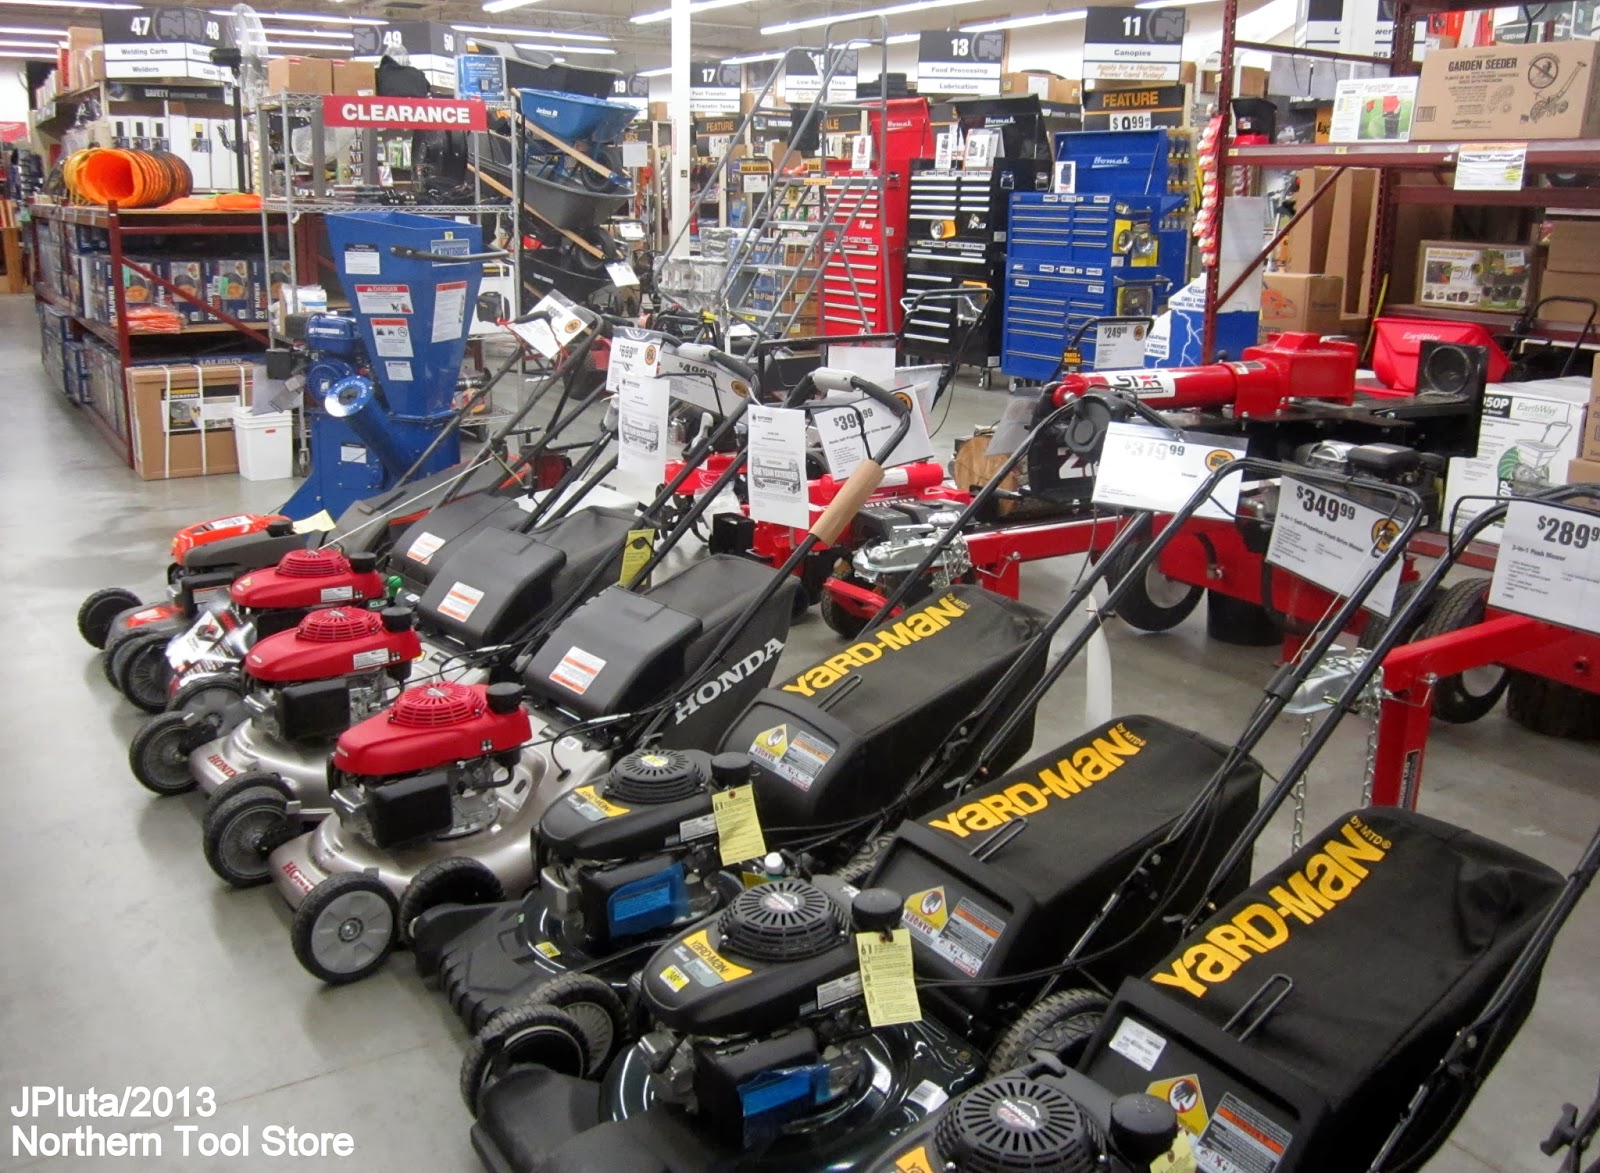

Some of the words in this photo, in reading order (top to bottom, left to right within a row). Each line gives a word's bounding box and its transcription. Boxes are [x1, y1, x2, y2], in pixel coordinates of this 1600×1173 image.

[131, 17, 150, 36] 47
[206, 21, 219, 40] 48
[1123, 16, 1140, 36] 11
[383, 32, 401, 47] 49
[444, 34, 453, 52] 50
[121, 47, 148, 56] Welding
[150, 47, 168, 55] Carts
[951, 39, 968, 56] 13
[1114, 49, 1151, 58] Canopies
[950, 67, 988, 75] Processing
[1448, 60, 1482, 72] GARDEN
[1485, 58, 1518, 70] SEEDER
[702, 69, 715, 82] 17
[614, 80, 626, 92] 19
[1103, 91, 1158, 107] FEATURE
[342, 104, 470, 124] CLEARANCE
[985, 116, 1015, 124] Homak
[706, 121, 734, 131] FEATURE
[1094, 156, 1130, 165] Homak
[1403, 332, 1442, 341] EarthWay
[1516, 402, 1557, 417] EarthWay
[1296, 485, 1356, 522] $34999
[1537, 515, 1600, 549] $2899
[1530, 548, 1544, 557] Push
[1546, 551, 1566, 561] Mower
[675, 637, 784, 725] HONDA
[208, 754, 237, 777] HOND
[1350, 815, 1361, 828] by
[904, 911, 933, 935] DANGER
[1002, 1099, 1036, 1127] HONDA
